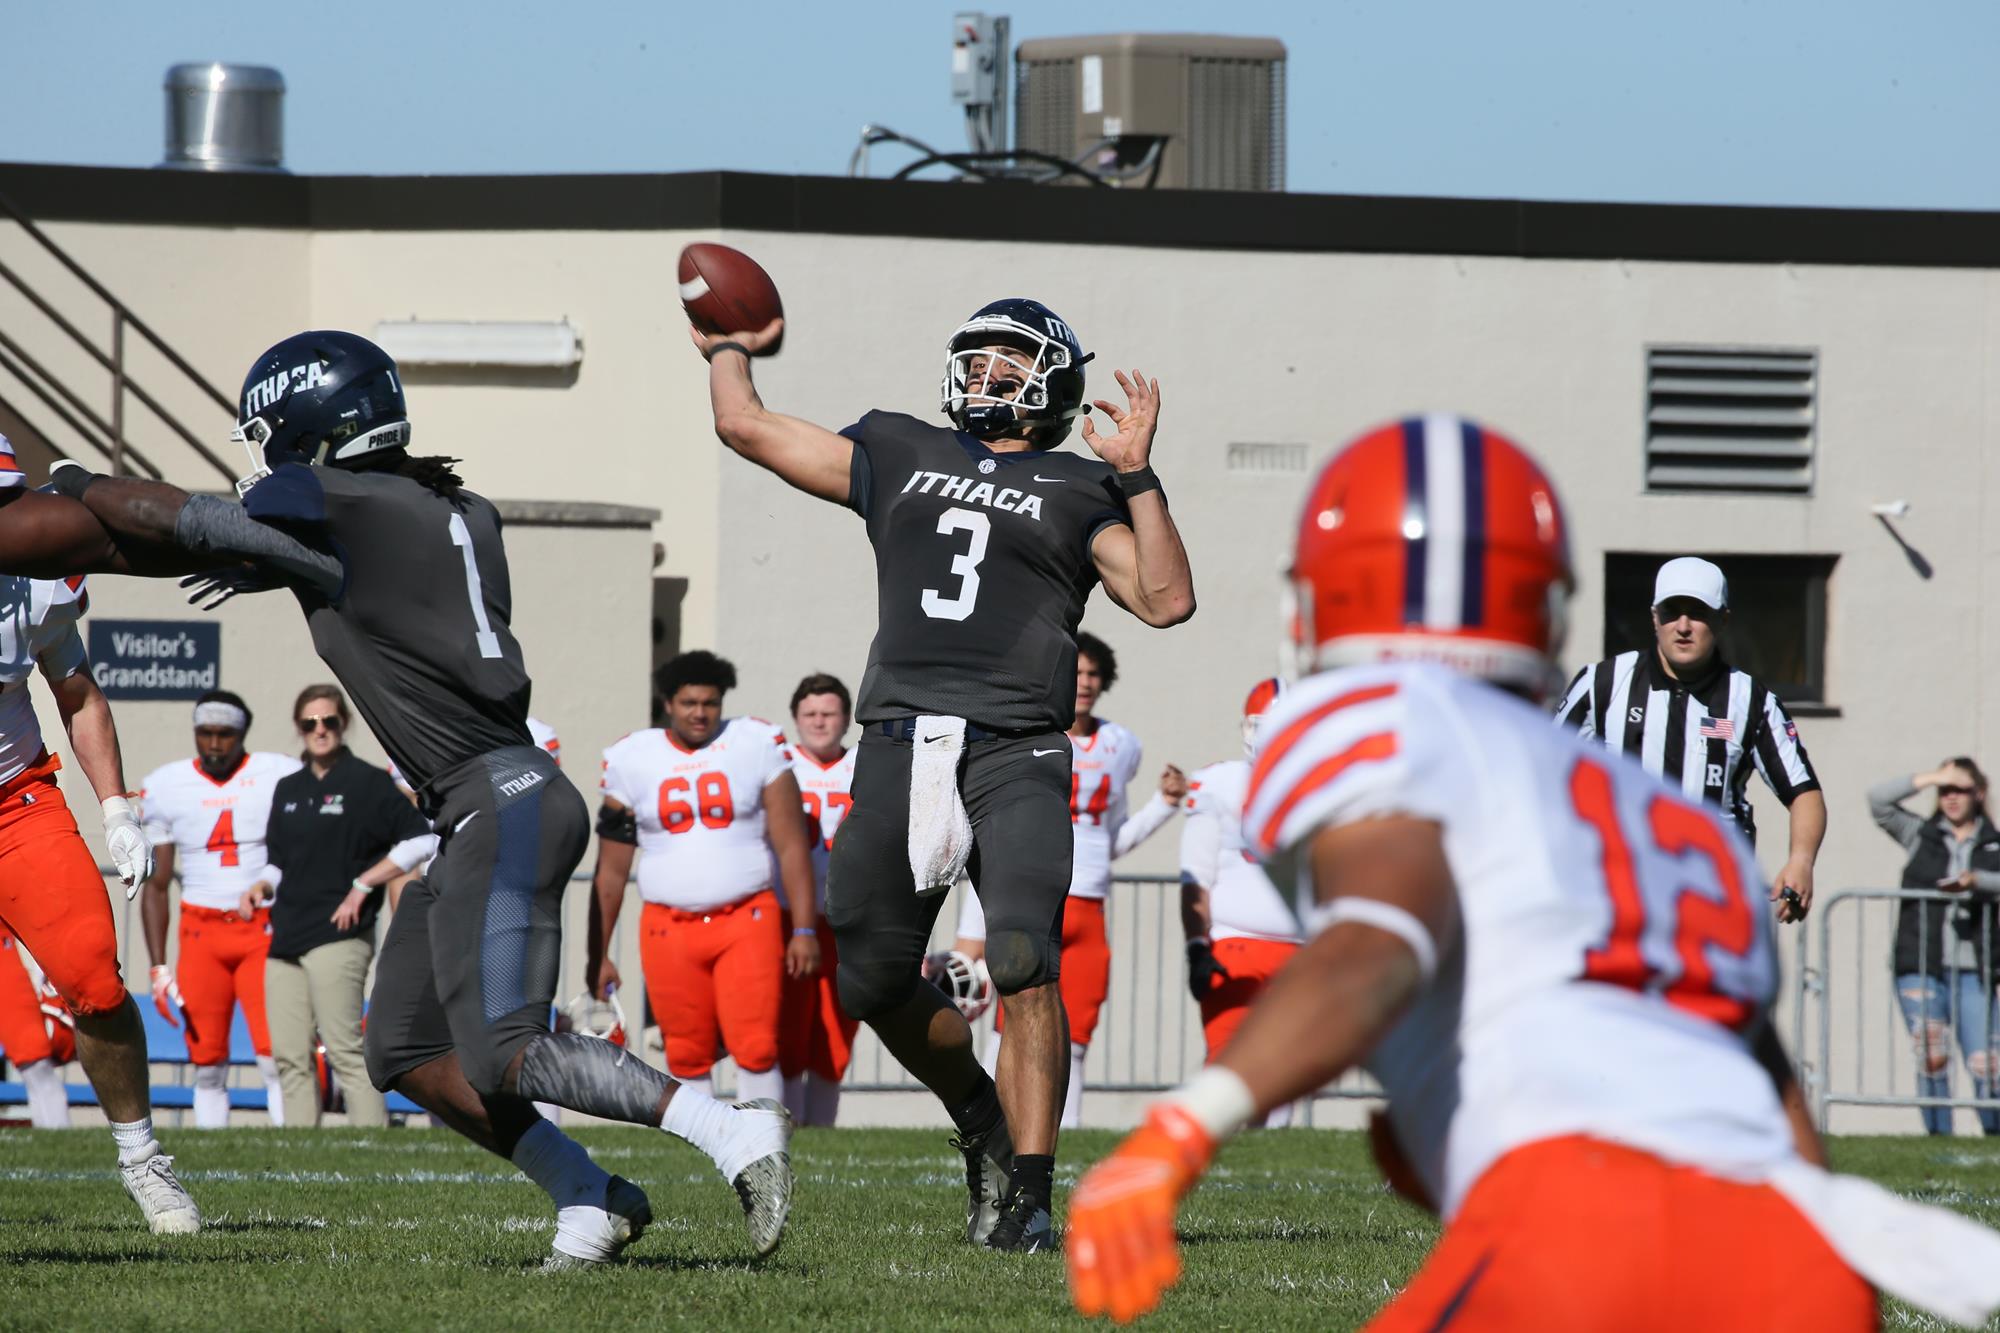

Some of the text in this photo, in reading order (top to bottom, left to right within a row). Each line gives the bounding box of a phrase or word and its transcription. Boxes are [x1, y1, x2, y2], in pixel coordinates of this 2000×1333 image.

[246, 361, 329, 418] ITHACA
[386, 370, 399, 393] 1
[368, 429, 399, 448] PRIDE
[901, 471, 1044, 521] ITHACA
[920, 507, 992, 622] 3
[449, 512, 503, 658] 1
[111, 631, 197, 659] Visitor's
[93, 661, 216, 689] Grandstand
[1628, 706, 1644, 723] S
[499, 770, 543, 797] ITHACA
[1706, 763, 1723, 786] R
[658, 770, 735, 835] 68
[206, 808, 240, 867] 4
[1569, 756, 1755, 1029] 12
